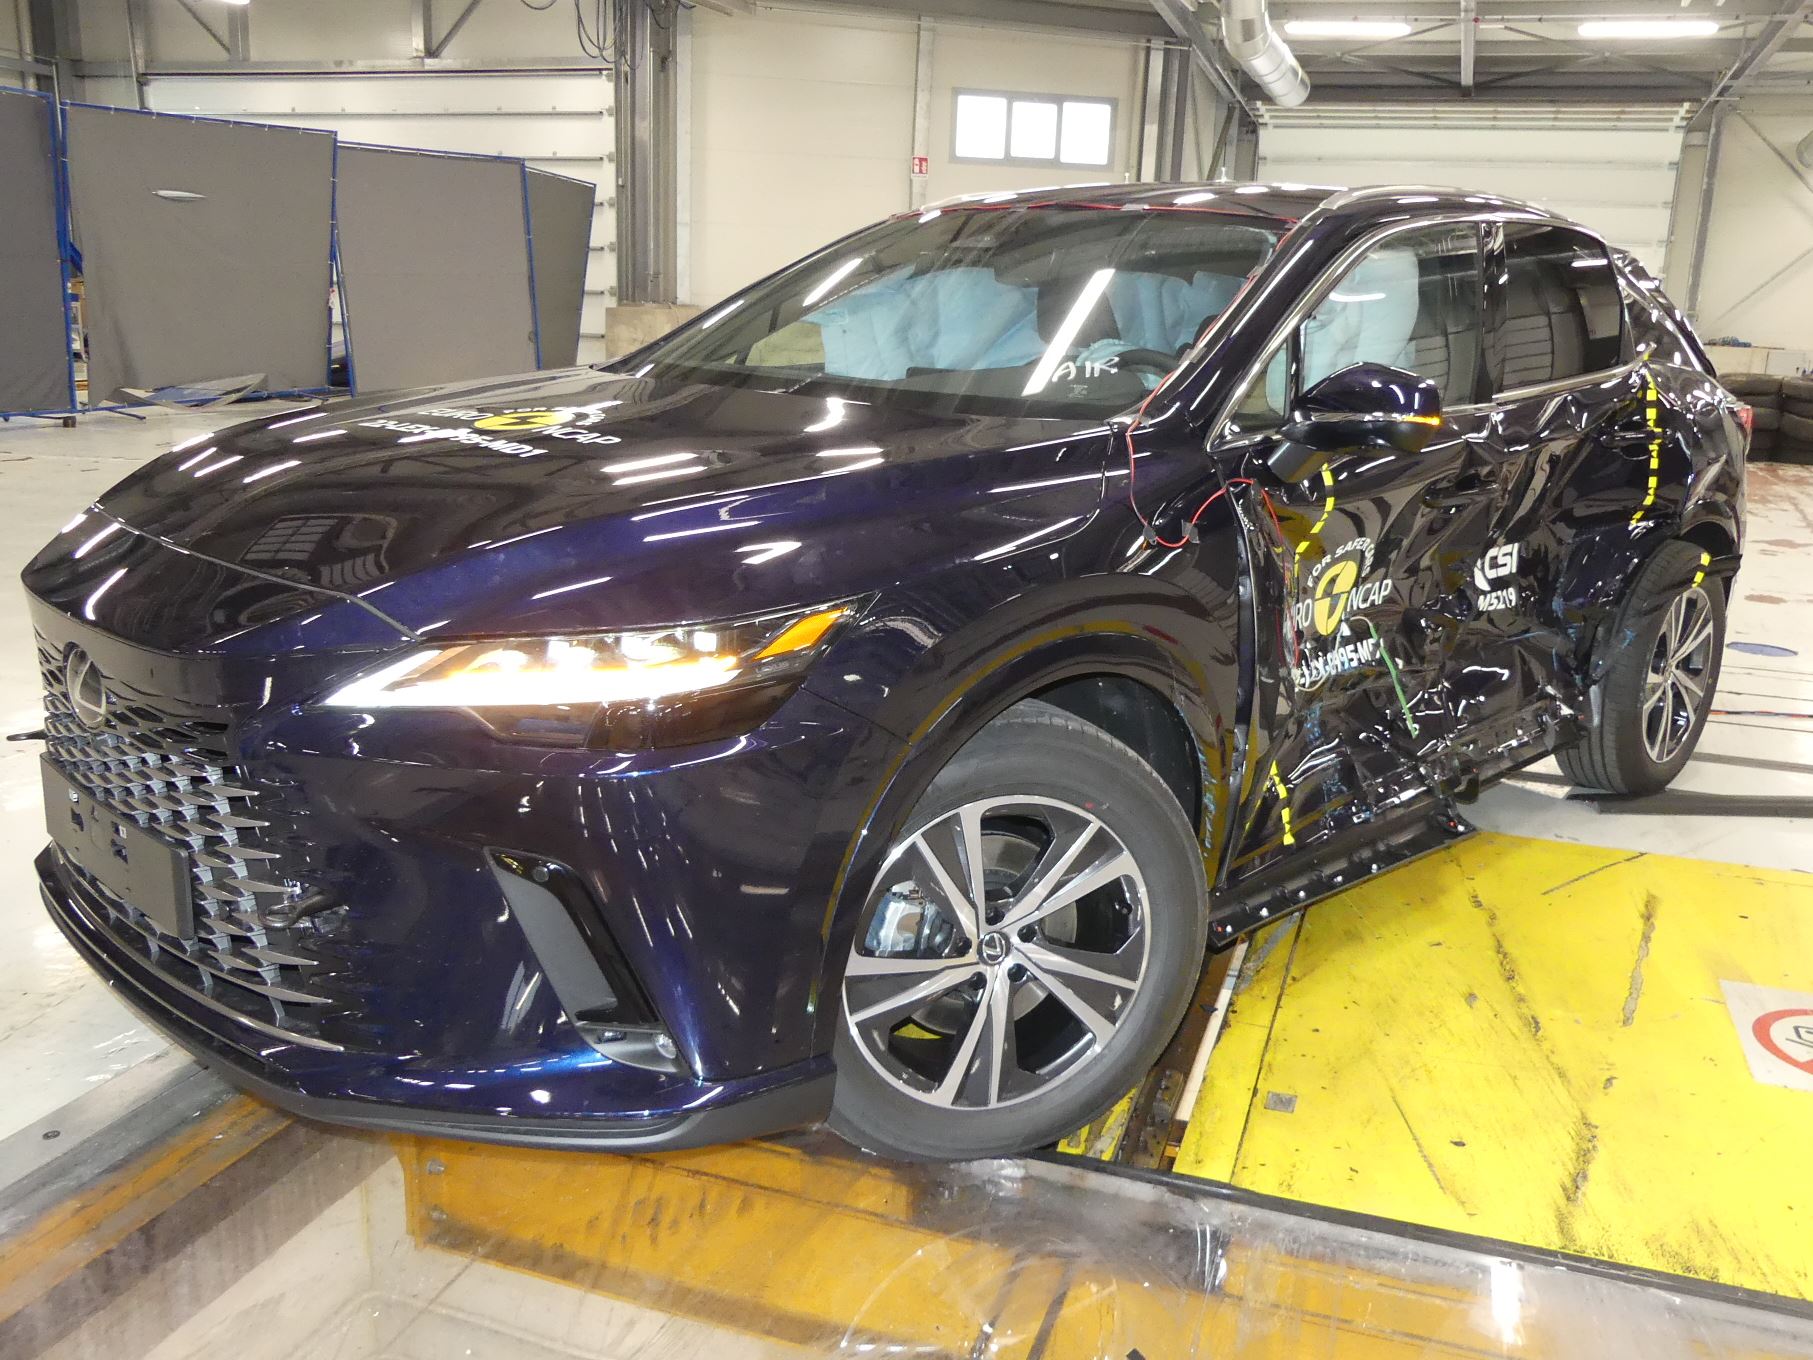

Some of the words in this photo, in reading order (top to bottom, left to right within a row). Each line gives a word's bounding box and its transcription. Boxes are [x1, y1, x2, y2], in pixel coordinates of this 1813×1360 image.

[1052, 356, 1120, 382] AIR
[417, 408, 494, 421] EURO
[532, 425, 622, 444] NCAP
[1307, 554, 1332, 587] FOR
[1334, 537, 1371, 558] SAFER
[1484, 542, 1519, 579] CSI
[1346, 579, 1392, 611] NCAP
[1477, 587, 1516, 612] M5219
